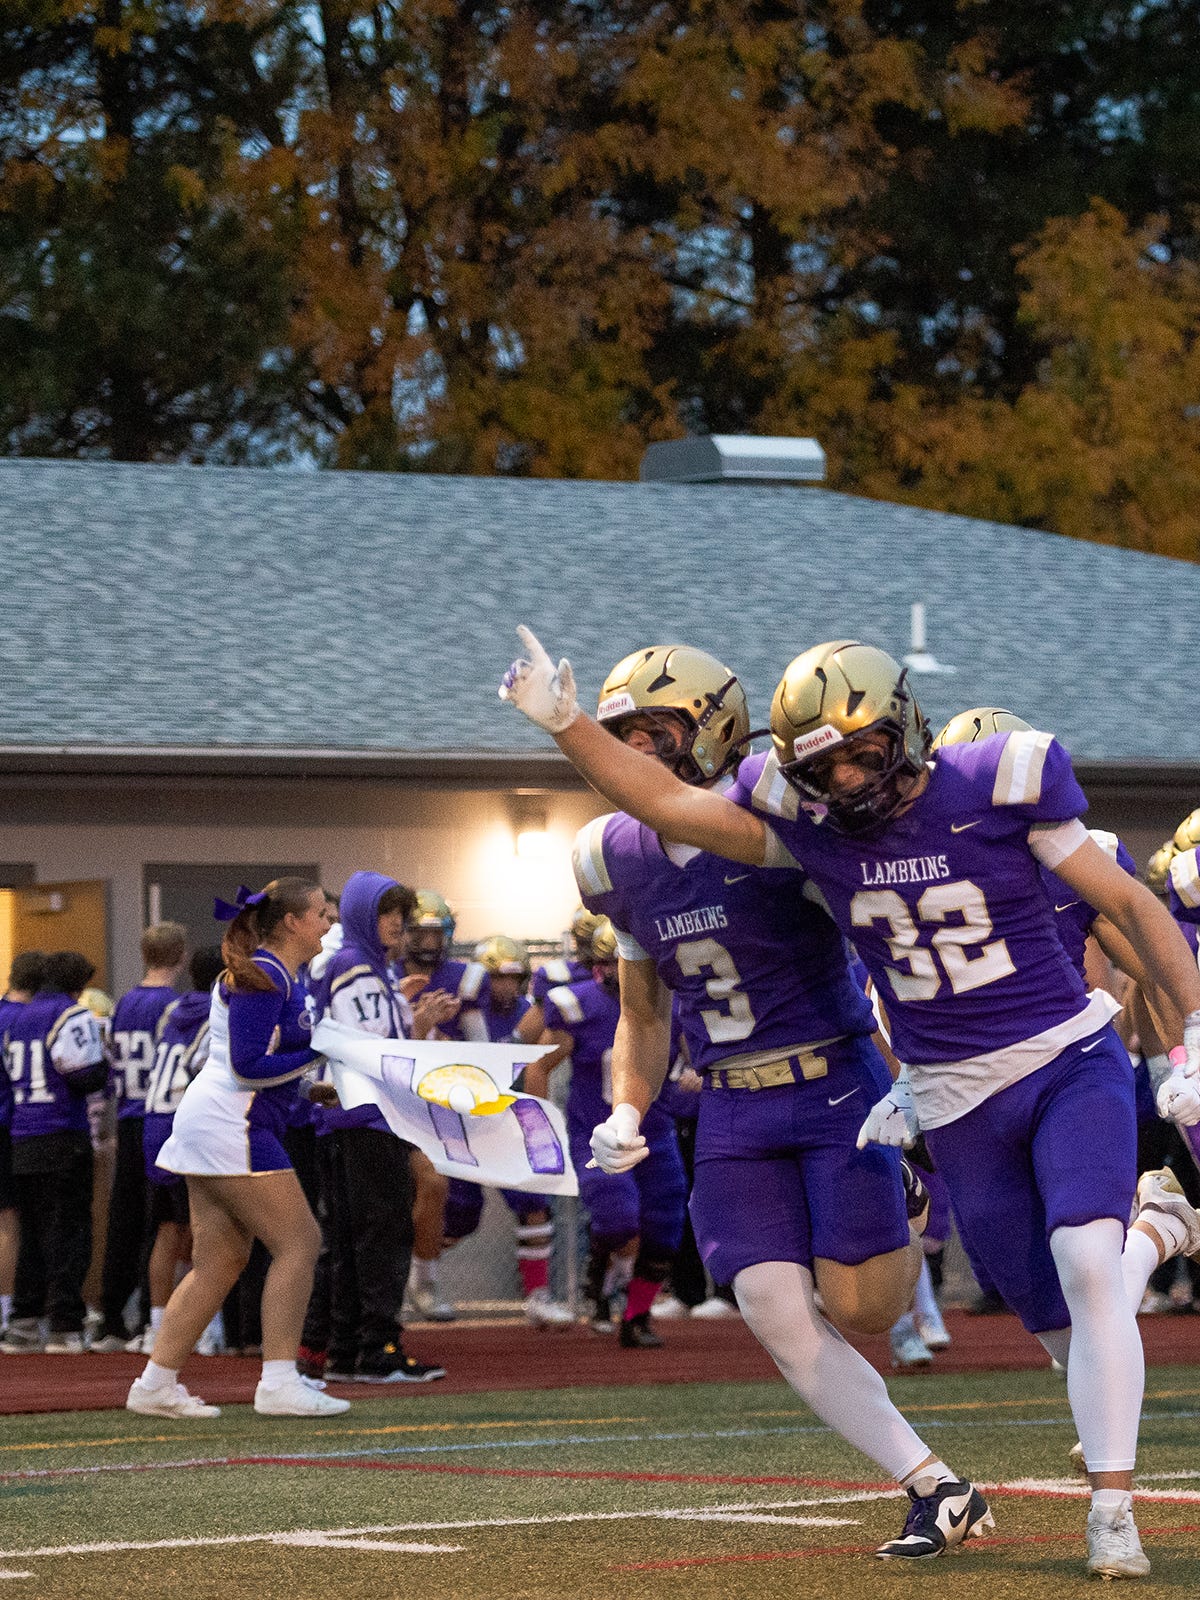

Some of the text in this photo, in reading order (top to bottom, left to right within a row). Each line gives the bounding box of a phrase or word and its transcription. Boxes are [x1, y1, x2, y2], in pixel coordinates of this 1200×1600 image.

[795, 730, 834, 753] Riddell
[861, 855, 950, 885] LAMBKINS
[655, 905, 728, 941] LAMBKINS
[850, 880, 1017, 1001] 32
[353, 993, 380, 1021] 17
[675, 938, 756, 1043] 3
